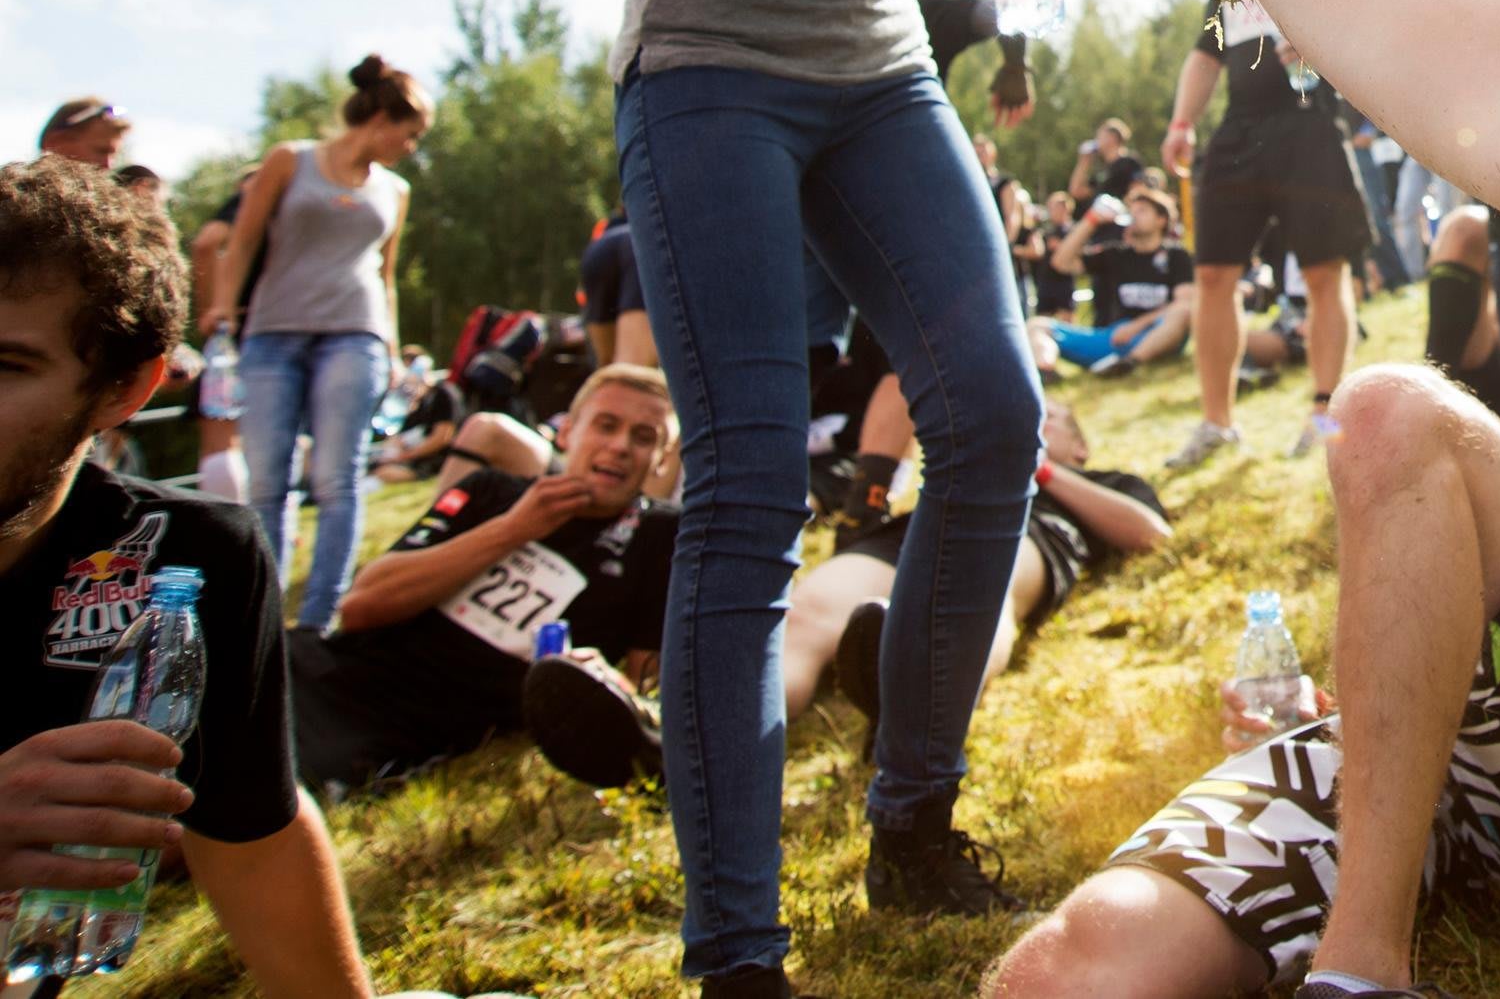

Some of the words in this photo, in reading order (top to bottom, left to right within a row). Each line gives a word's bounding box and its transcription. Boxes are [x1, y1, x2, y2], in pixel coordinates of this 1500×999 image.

[52, 582, 101, 610] Red
[470, 565, 555, 632] 227
[47, 601, 142, 639] 400
